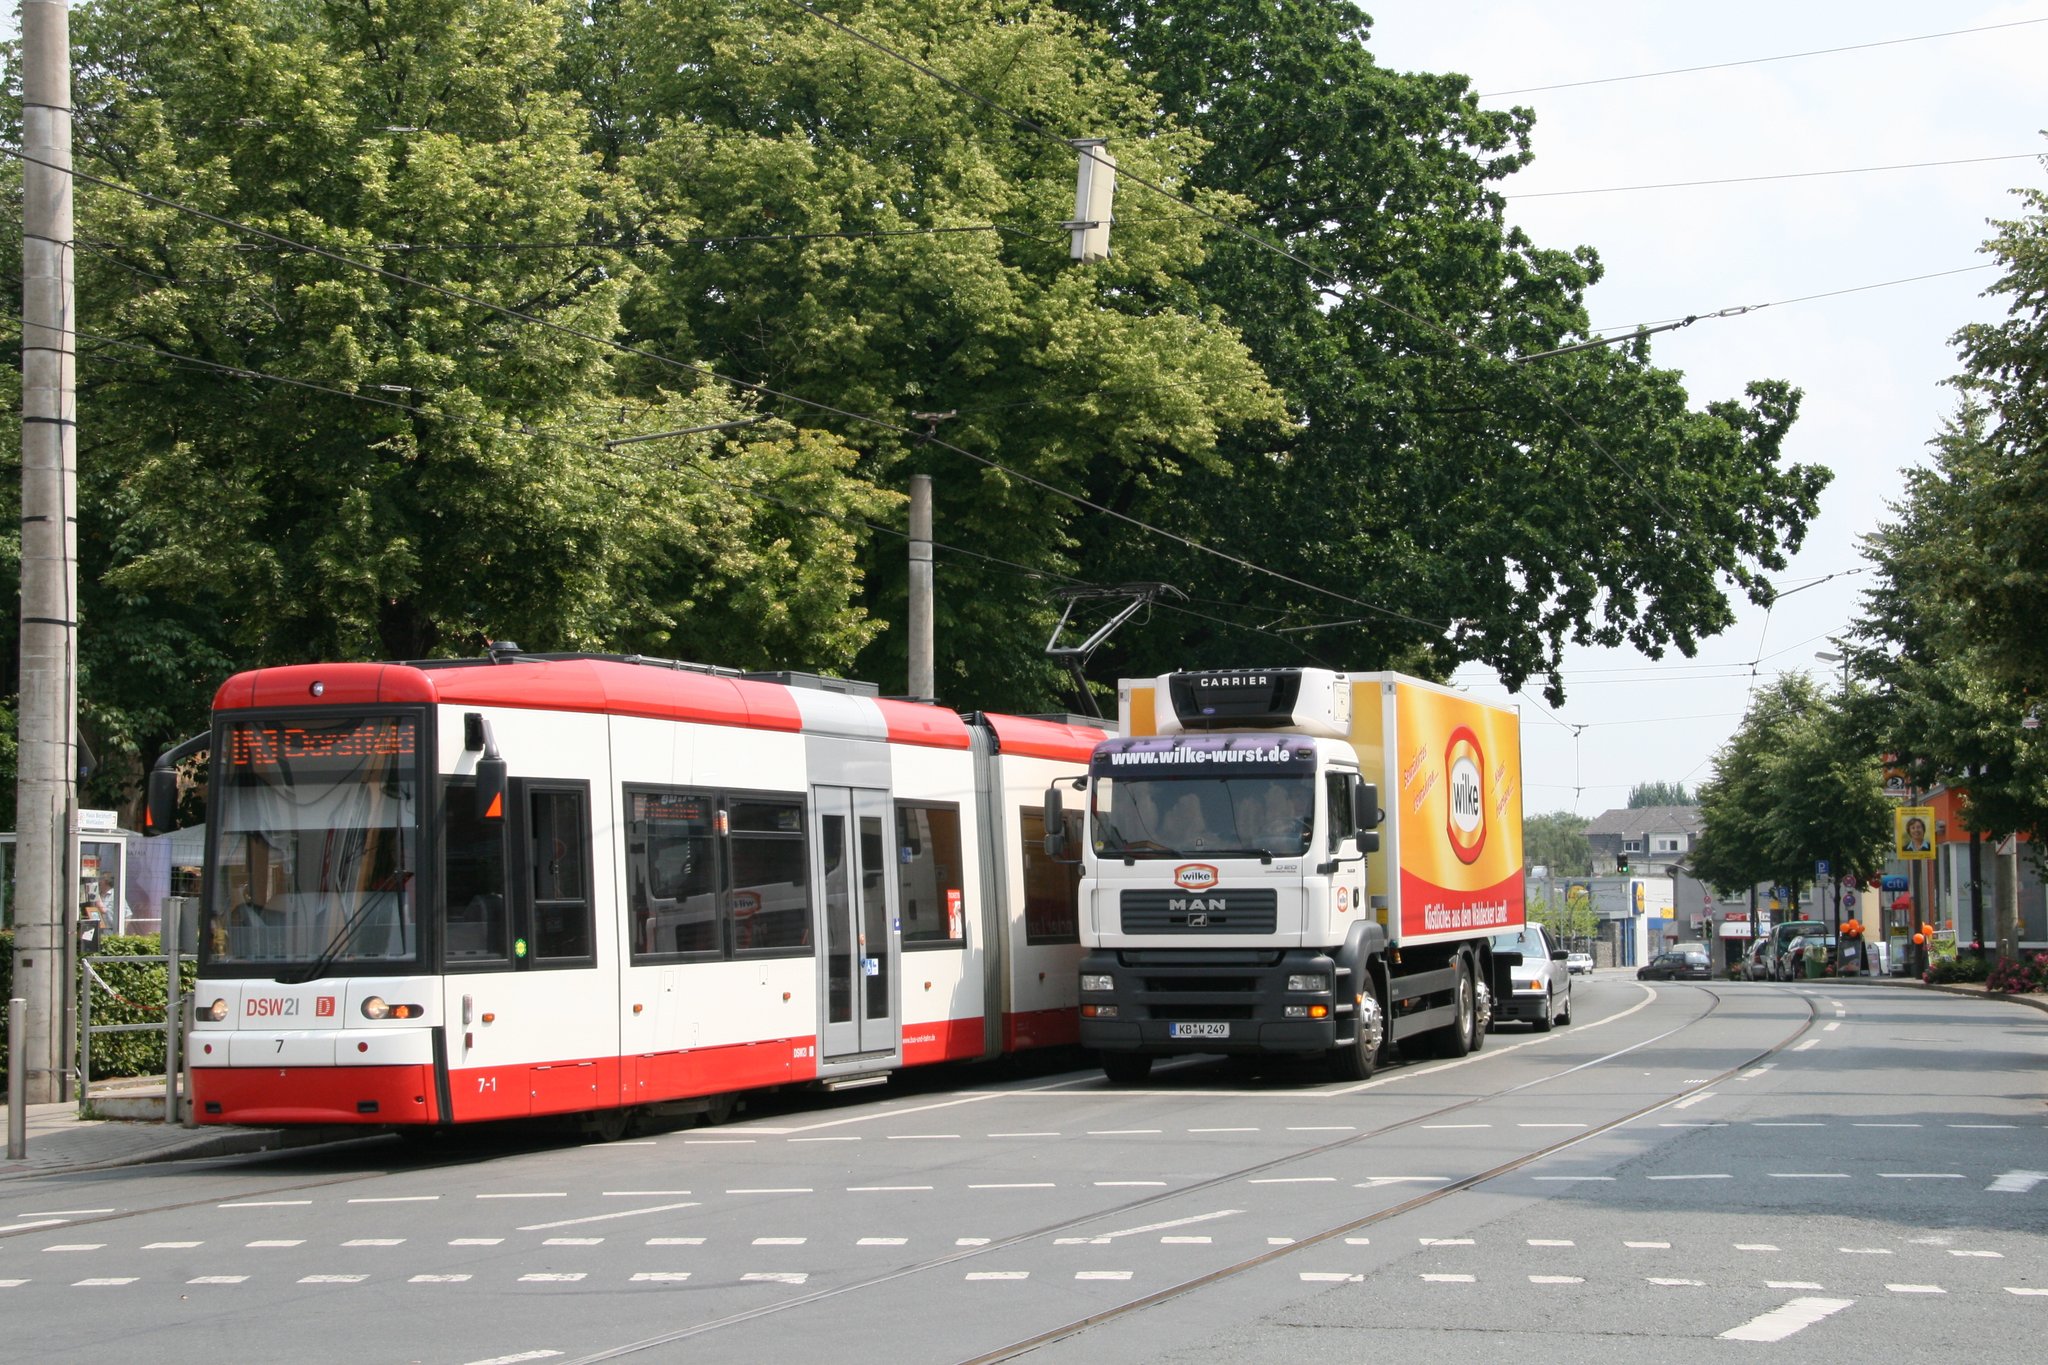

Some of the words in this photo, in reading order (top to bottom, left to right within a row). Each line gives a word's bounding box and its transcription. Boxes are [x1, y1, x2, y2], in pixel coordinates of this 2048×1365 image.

[1201, 676, 1267, 687] CARRIER
[1111, 746, 1290, 766] www.wilke-wurst.de
[1453, 773, 1479, 816] wilke
[1818, 862, 1825, 873] P
[1182, 872, 1211, 881] wilke
[1887, 879, 1904, 888] citi
[1169, 899, 1226, 910] MAN
[1452, 909, 1461, 928] aus
[246, 997, 300, 1017] DSW21
[1179, 1024, 1192, 1034] KB
[1198, 1024, 1205, 1034] W
[1207, 1024, 1225, 1034] 249
[275, 1039, 285, 1053] 7
[477, 1077, 497, 1093] 7-1
